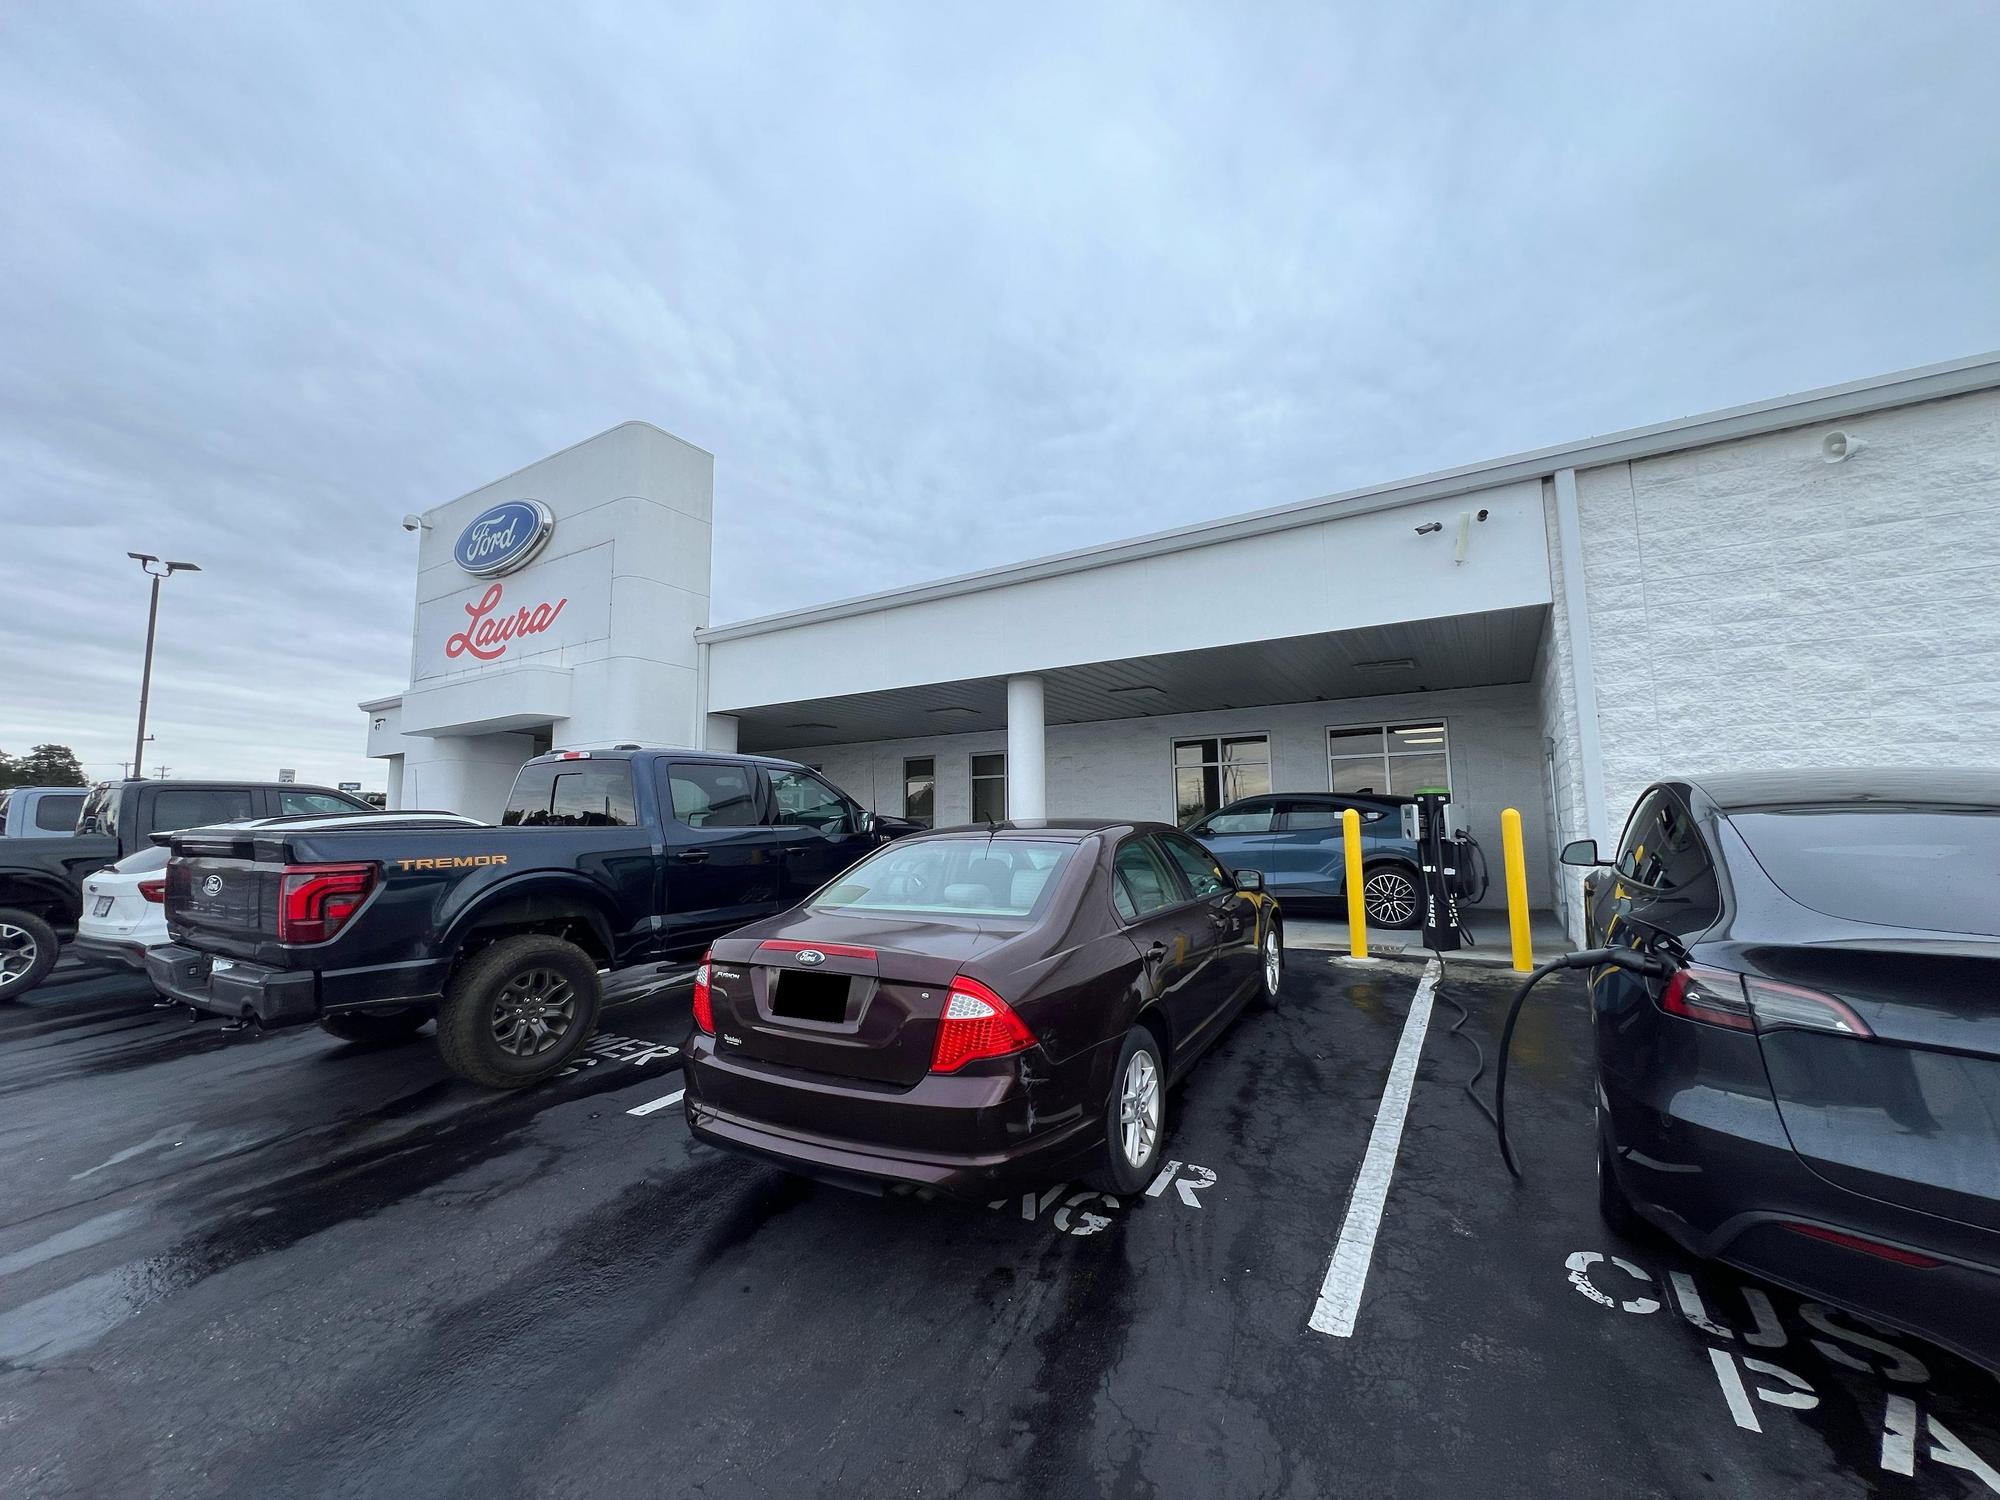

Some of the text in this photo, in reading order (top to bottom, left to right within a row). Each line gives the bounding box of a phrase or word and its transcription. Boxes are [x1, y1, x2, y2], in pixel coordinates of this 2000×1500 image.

[466, 514, 518, 562] Ford
[445, 582, 568, 661] Laura
[397, 855, 508, 871] TREMOR
